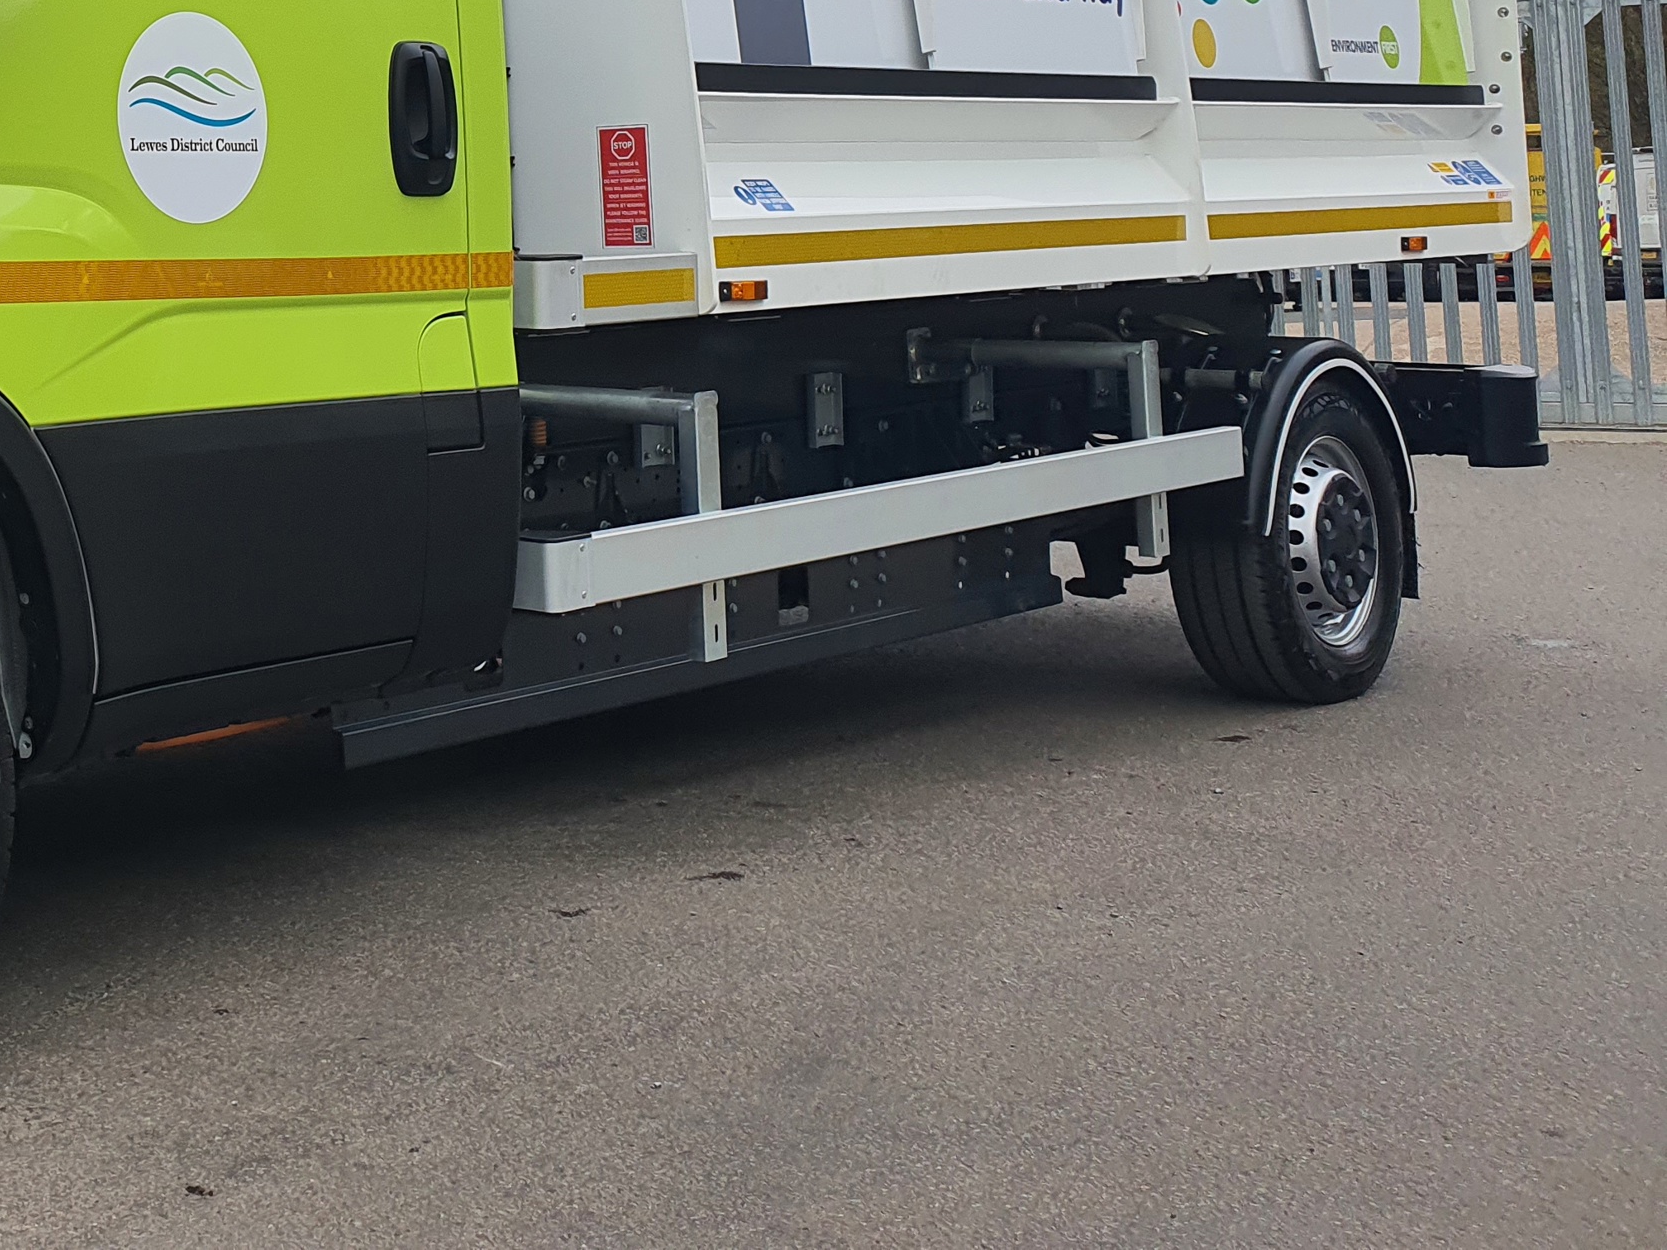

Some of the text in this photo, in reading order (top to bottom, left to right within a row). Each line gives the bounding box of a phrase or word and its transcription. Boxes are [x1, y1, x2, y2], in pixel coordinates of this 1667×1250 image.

[1331, 39, 1379, 53] ENVIRONMENT
[130, 137, 259, 152] Lewes District Council
